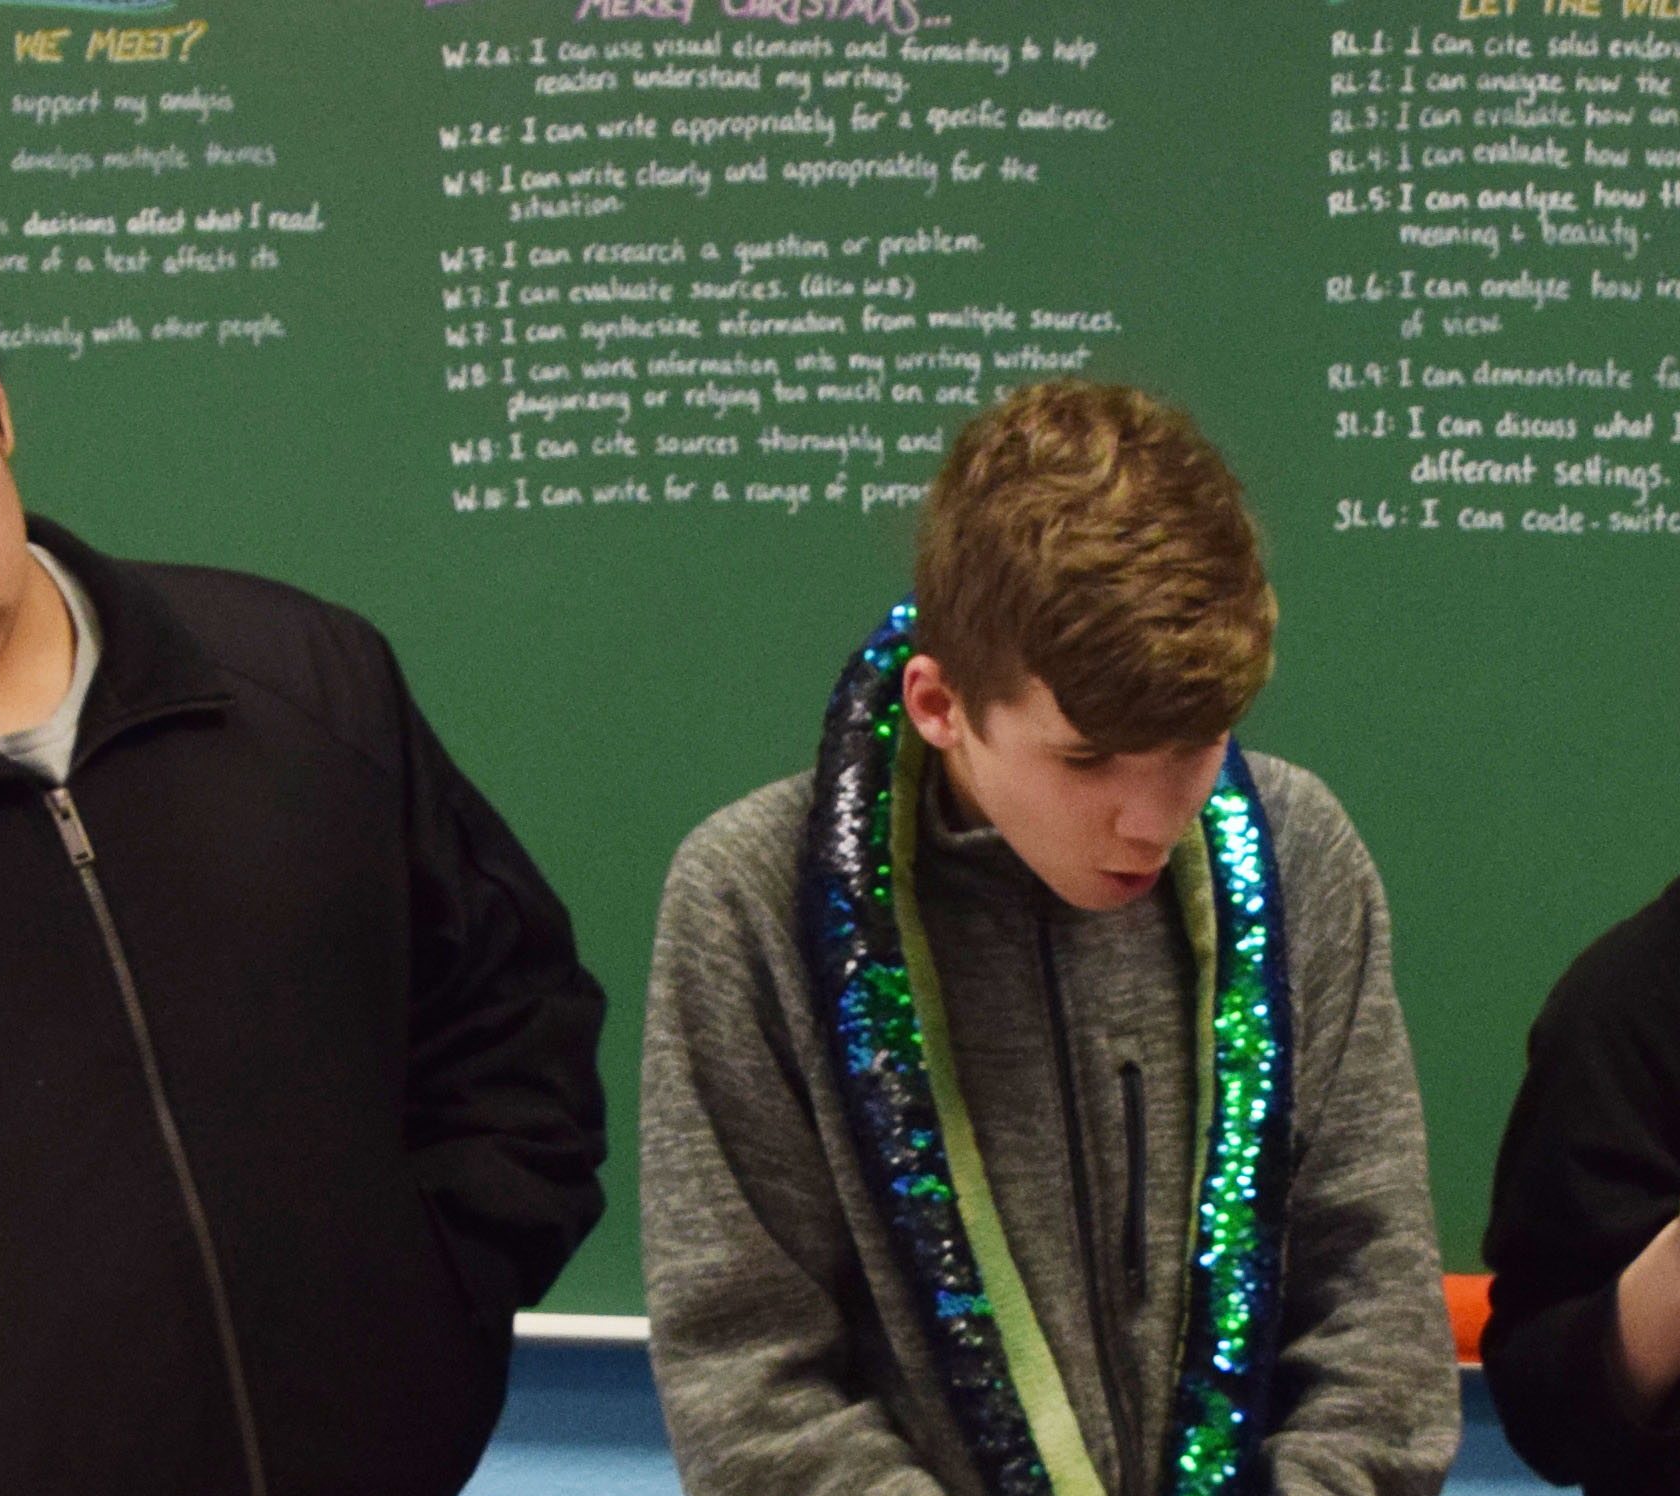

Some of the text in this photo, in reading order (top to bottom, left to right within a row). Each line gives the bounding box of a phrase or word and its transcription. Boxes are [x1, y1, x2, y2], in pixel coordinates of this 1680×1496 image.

[14, 28, 72, 63] WE
[85, 18, 209, 63] MEET?
[442, 41, 519, 68] W.2a:
[530, 37, 547, 65] I
[558, 41, 597, 61] can
[603, 41, 644, 60] use
[653, 30, 721, 57] visual
[732, 33, 834, 59] elements
[845, 32, 888, 59] and
[1021, 35, 1042, 61] to
[1053, 36, 1098, 70] help
[1330, 30, 1394, 58] RL.1:
[1404, 26, 1421, 57] I
[1432, 33, 1473, 55] can
[1485, 30, 1532, 58] cite
[1548, 30, 1599, 57] solid
[11, 88, 102, 125] support
[114, 97, 149, 125] my
[159, 85, 235, 124] analysis
[439, 98, 1113, 150] W.2e: I can write appropriately for a specific audience.
[23, 209, 117, 238] decisions
[126, 206, 186, 236] affect
[195, 208, 243, 232] what
[249, 201, 262, 229] I
[268, 202, 325, 232] read.
[1327, 189, 1391, 216] RL.5:
[1398, 183, 1414, 213] I
[1425, 190, 1469, 211] can
[1477, 181, 1578, 223] analyze
[1594, 180, 1647, 210] how
[1326, 275, 1393, 302] RL.6:
[1399, 270, 1416, 299] I
[1424, 279, 1469, 298] can
[1481, 270, 1570, 311] analyze
[1591, 269, 1643, 300] how
[1327, 363, 1390, 390] RL.9:
[1398, 358, 1413, 388] I
[1422, 366, 1466, 387] can
[1472, 360, 1633, 390] demonstrate
[1333, 411, 1395, 439] SL.1:
[1408, 407, 1425, 439] I
[1437, 414, 1483, 437] can
[1495, 412, 1578, 439] discuss
[1593, 411, 1655, 439] what
[450, 424, 943, 467] W.8: I can cite sources thoroughly and
[1410, 448, 1671, 506] different settings.
[1333, 500, 1408, 531] SL.6:
[1419, 499, 1440, 530] I
[1457, 509, 1505, 531] can
